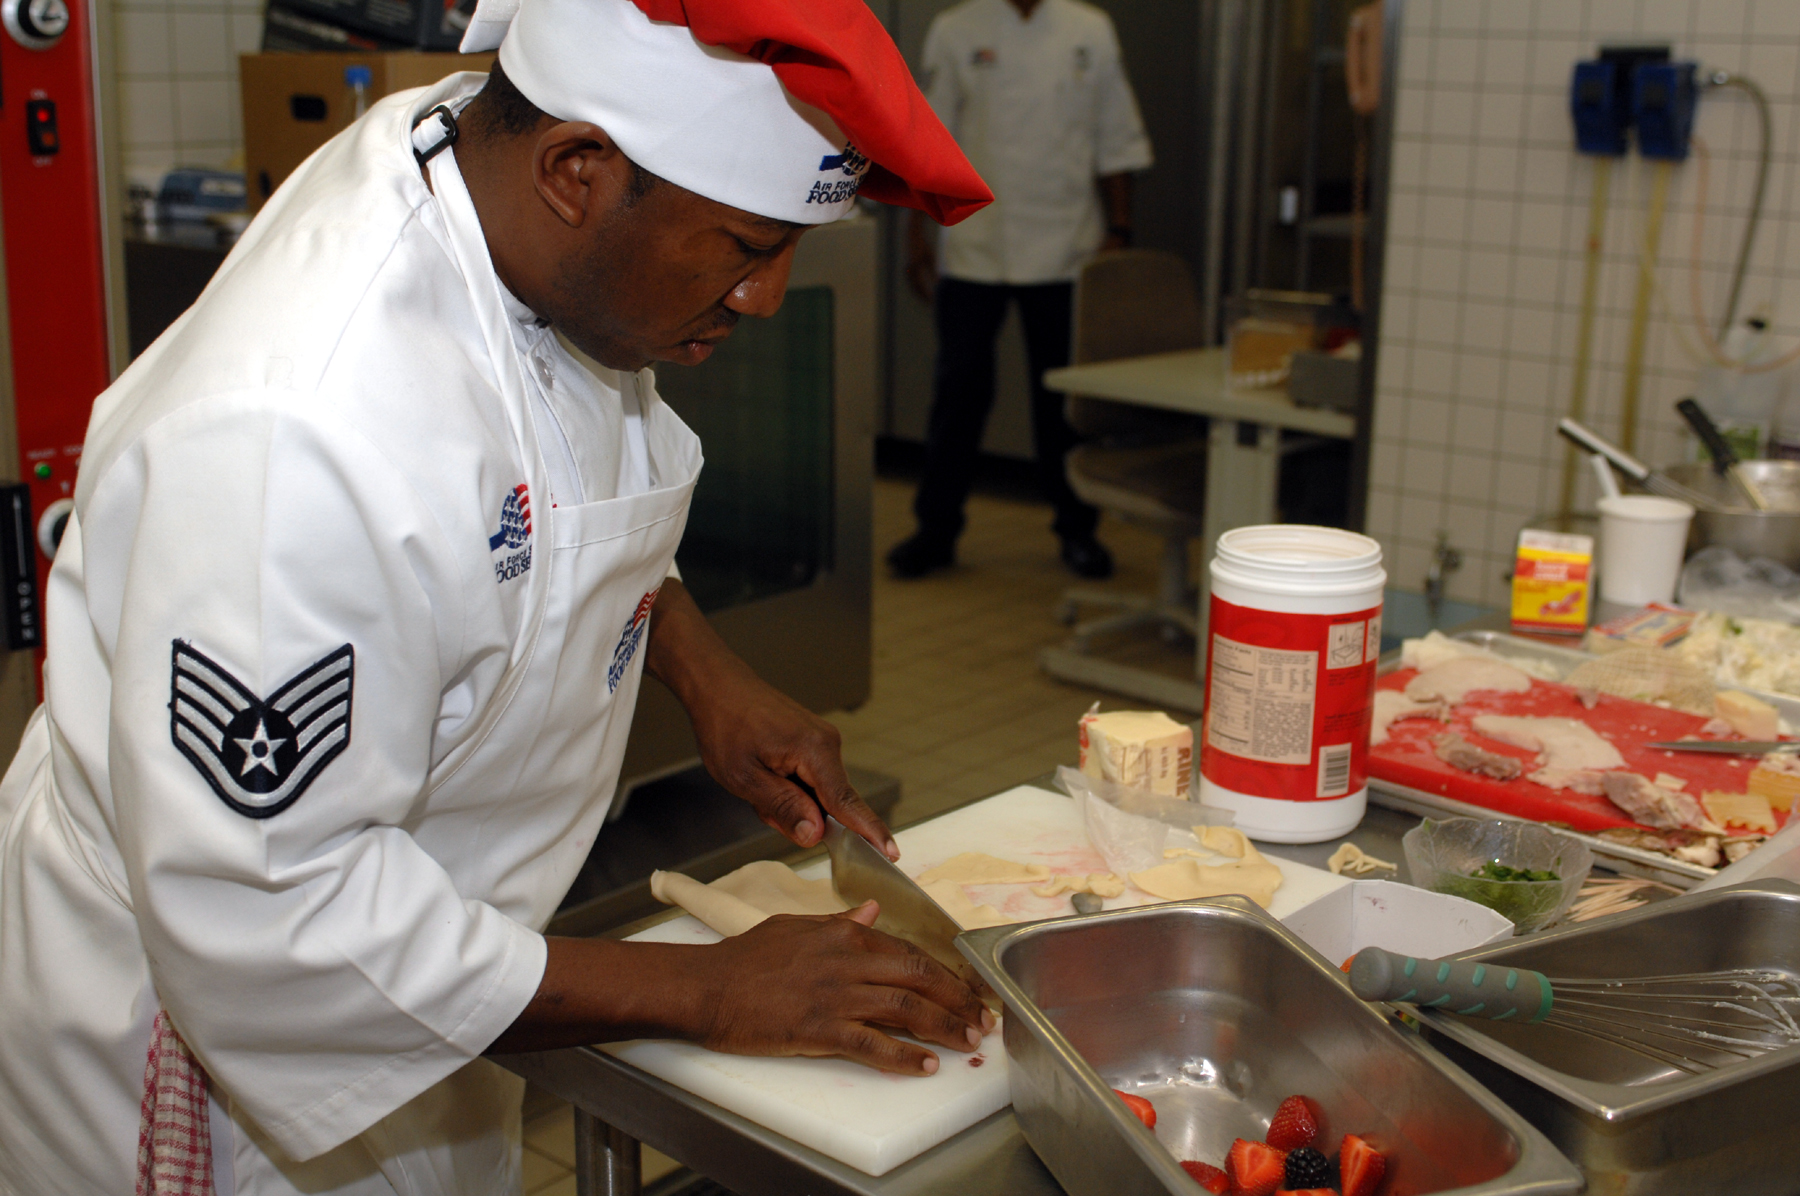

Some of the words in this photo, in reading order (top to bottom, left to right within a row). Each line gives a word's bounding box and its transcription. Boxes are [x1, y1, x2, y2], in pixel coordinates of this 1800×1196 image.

[813, 180, 832, 191] AIR
[805, 190, 846, 204] FOOD
[17, 581, 35, 641] OPEN
